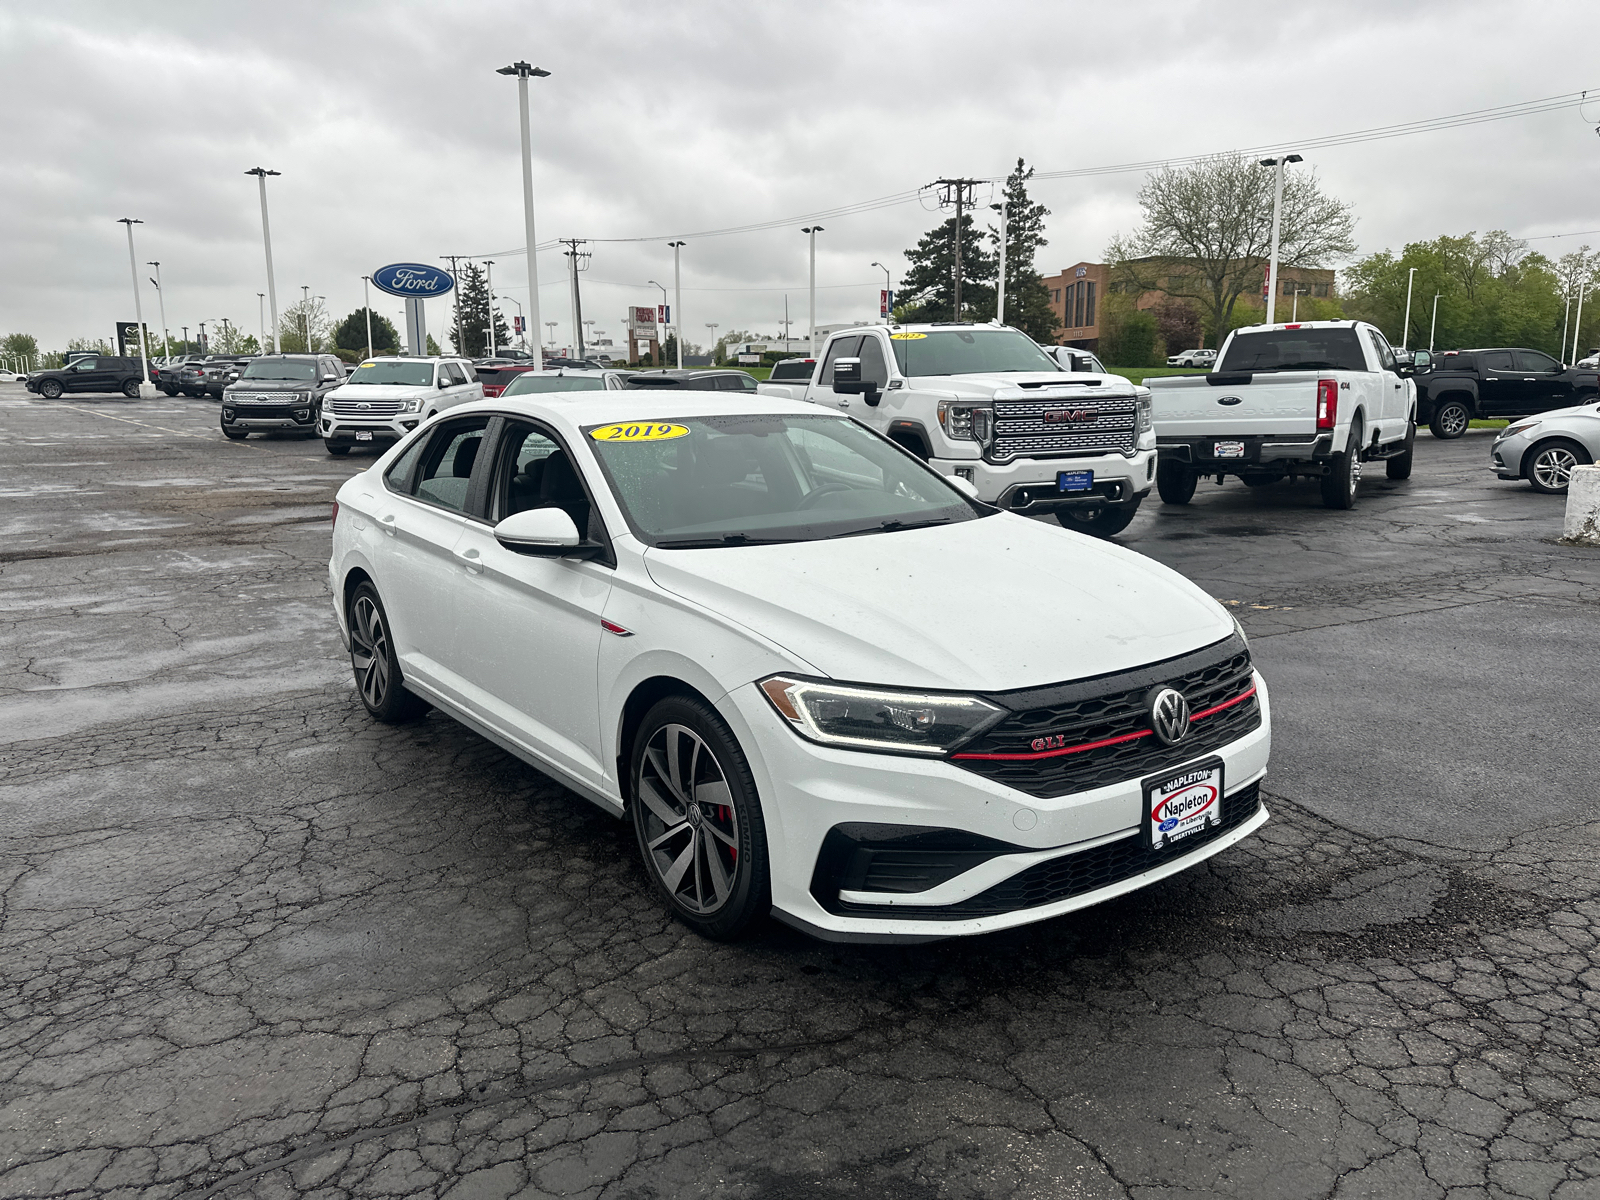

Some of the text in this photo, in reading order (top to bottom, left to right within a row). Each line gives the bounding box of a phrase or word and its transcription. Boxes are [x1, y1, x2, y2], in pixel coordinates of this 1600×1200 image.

[391, 268, 439, 291] Ford
[1044, 409, 1098, 422] GMC
[1157, 407, 1307, 418] SUPER DUTY
[607, 425, 672, 439] 2019
[1031, 735, 1065, 751] GLI
[1166, 770, 1209, 792] NAPLETON
[1164, 793, 1208, 819] Napleton
[739, 803, 751, 863] KUMHO
[1161, 818, 1177, 831] Ford
[1170, 824, 1205, 843] LIBERTYVILLE
